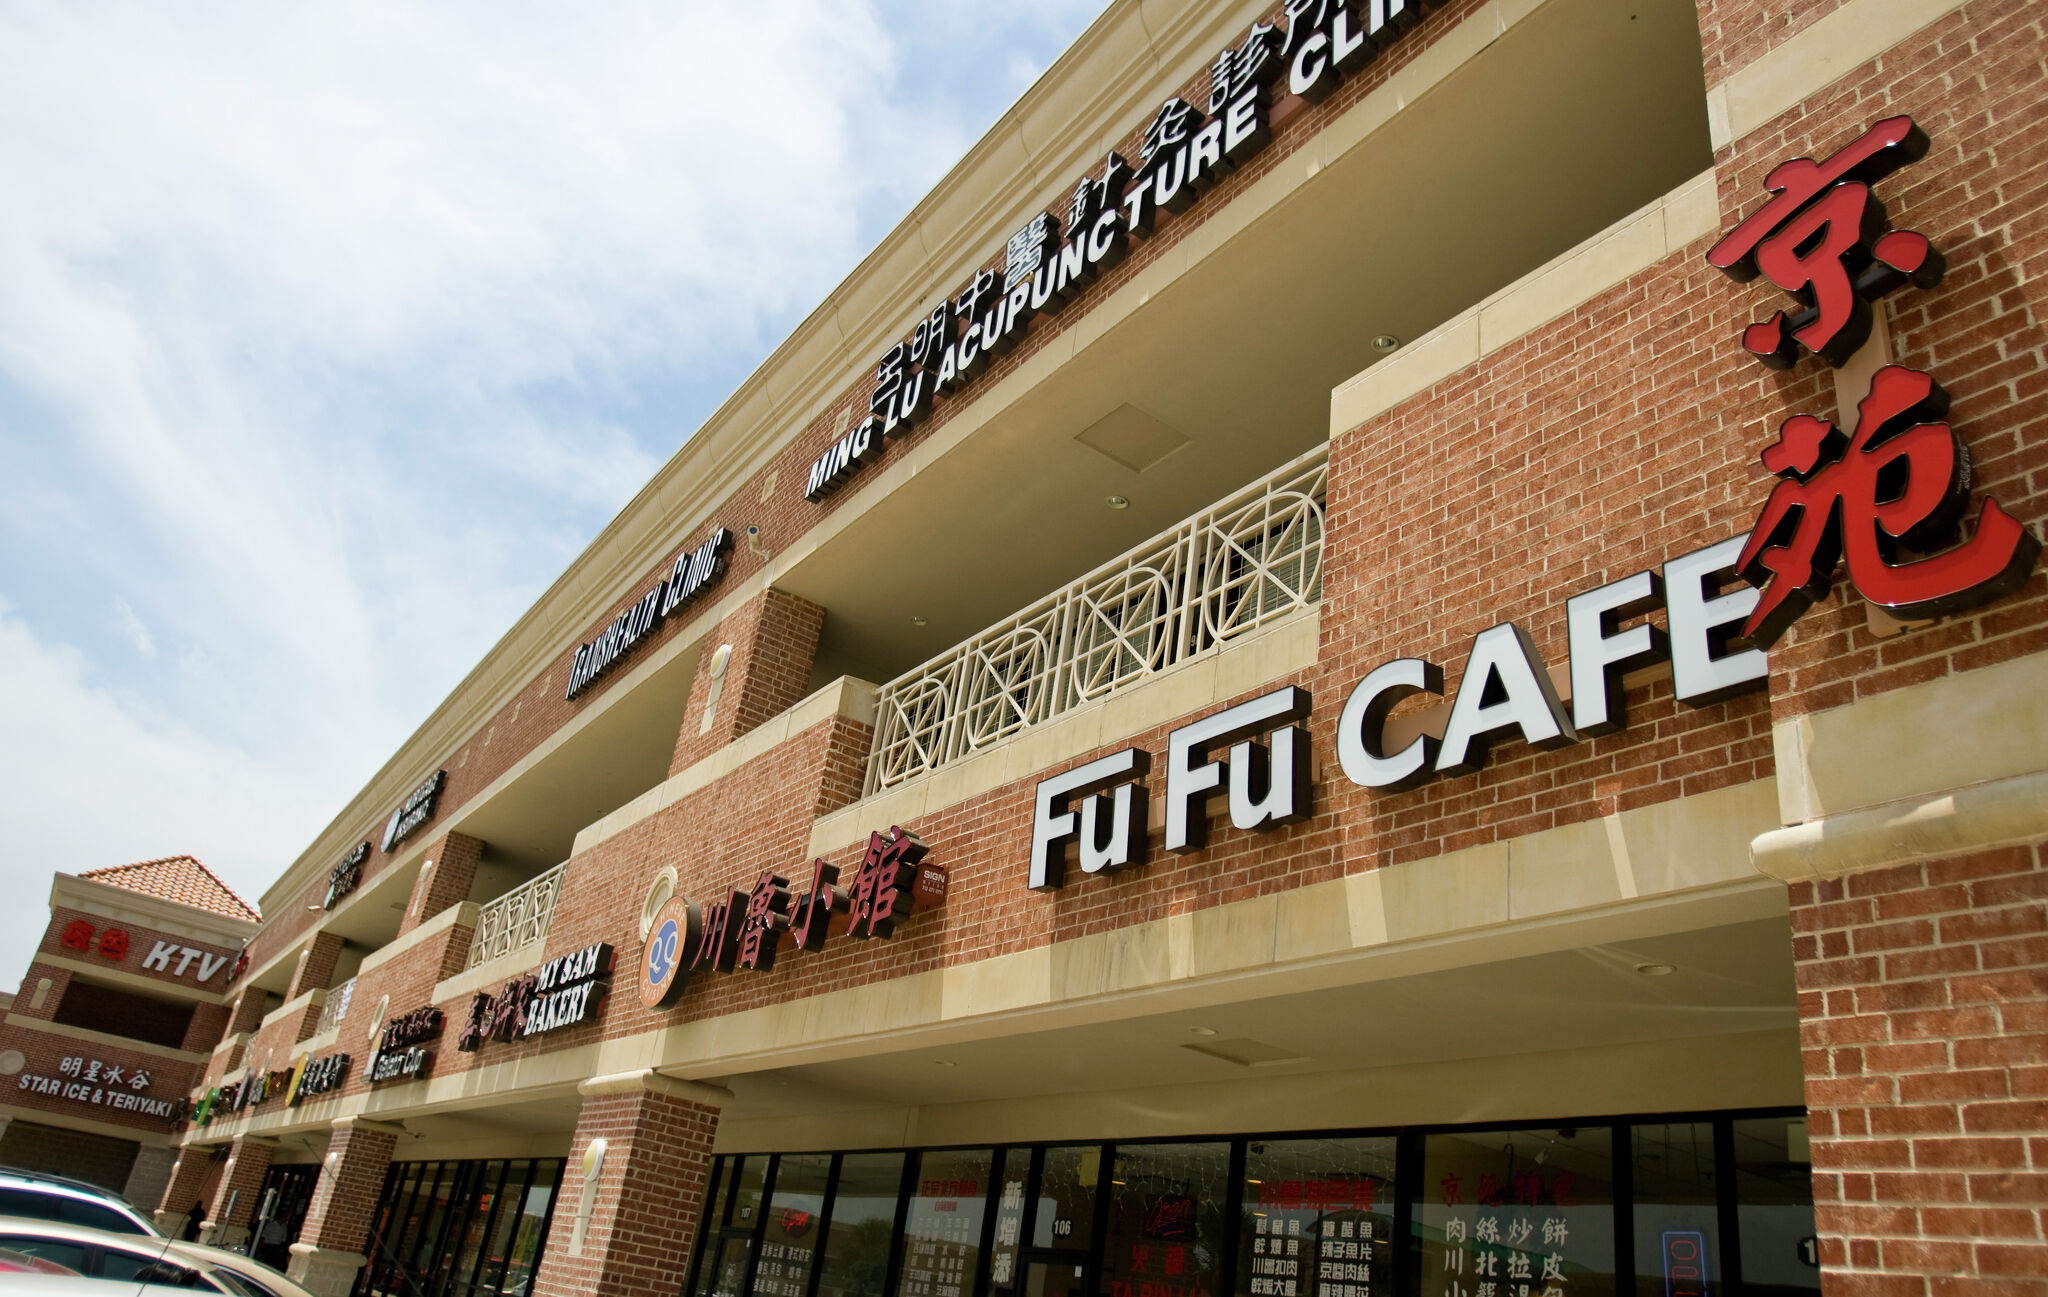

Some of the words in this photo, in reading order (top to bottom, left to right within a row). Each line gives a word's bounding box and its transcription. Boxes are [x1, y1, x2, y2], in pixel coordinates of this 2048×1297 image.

[805, 415, 873, 499] MING
[884, 368, 923, 435] LU
[934, 84, 1258, 393] ACUPUNCTURE
[1706, 114, 2023, 639] 京苑
[661, 527, 725, 617] CLINIC
[1337, 532, 1768, 789] CAFE
[923, 869, 946, 883] SIGN
[652, 902, 686, 935] CHINESE
[689, 825, 912, 972] 川魯小館
[142, 941, 228, 982] KTV
[534, 957, 562, 992] MY
[562, 941, 603, 980] SAM
[649, 931, 678, 974] QQ
[523, 980, 595, 1036] BAKERY
[59, 1056, 150, 1089] 明星冰谷
[19, 1074, 61, 1097] STAR
[62, 1082, 88, 1101] ICE
[91, 1089, 104, 1104] &
[106, 1091, 173, 1118] TERIYAKI
[1054, 1220, 1071, 1235] 106
[1445, 1216, 1569, 1249] 肉絲炒餅
[1444, 1247, 1569, 1282] 川北拉皮
